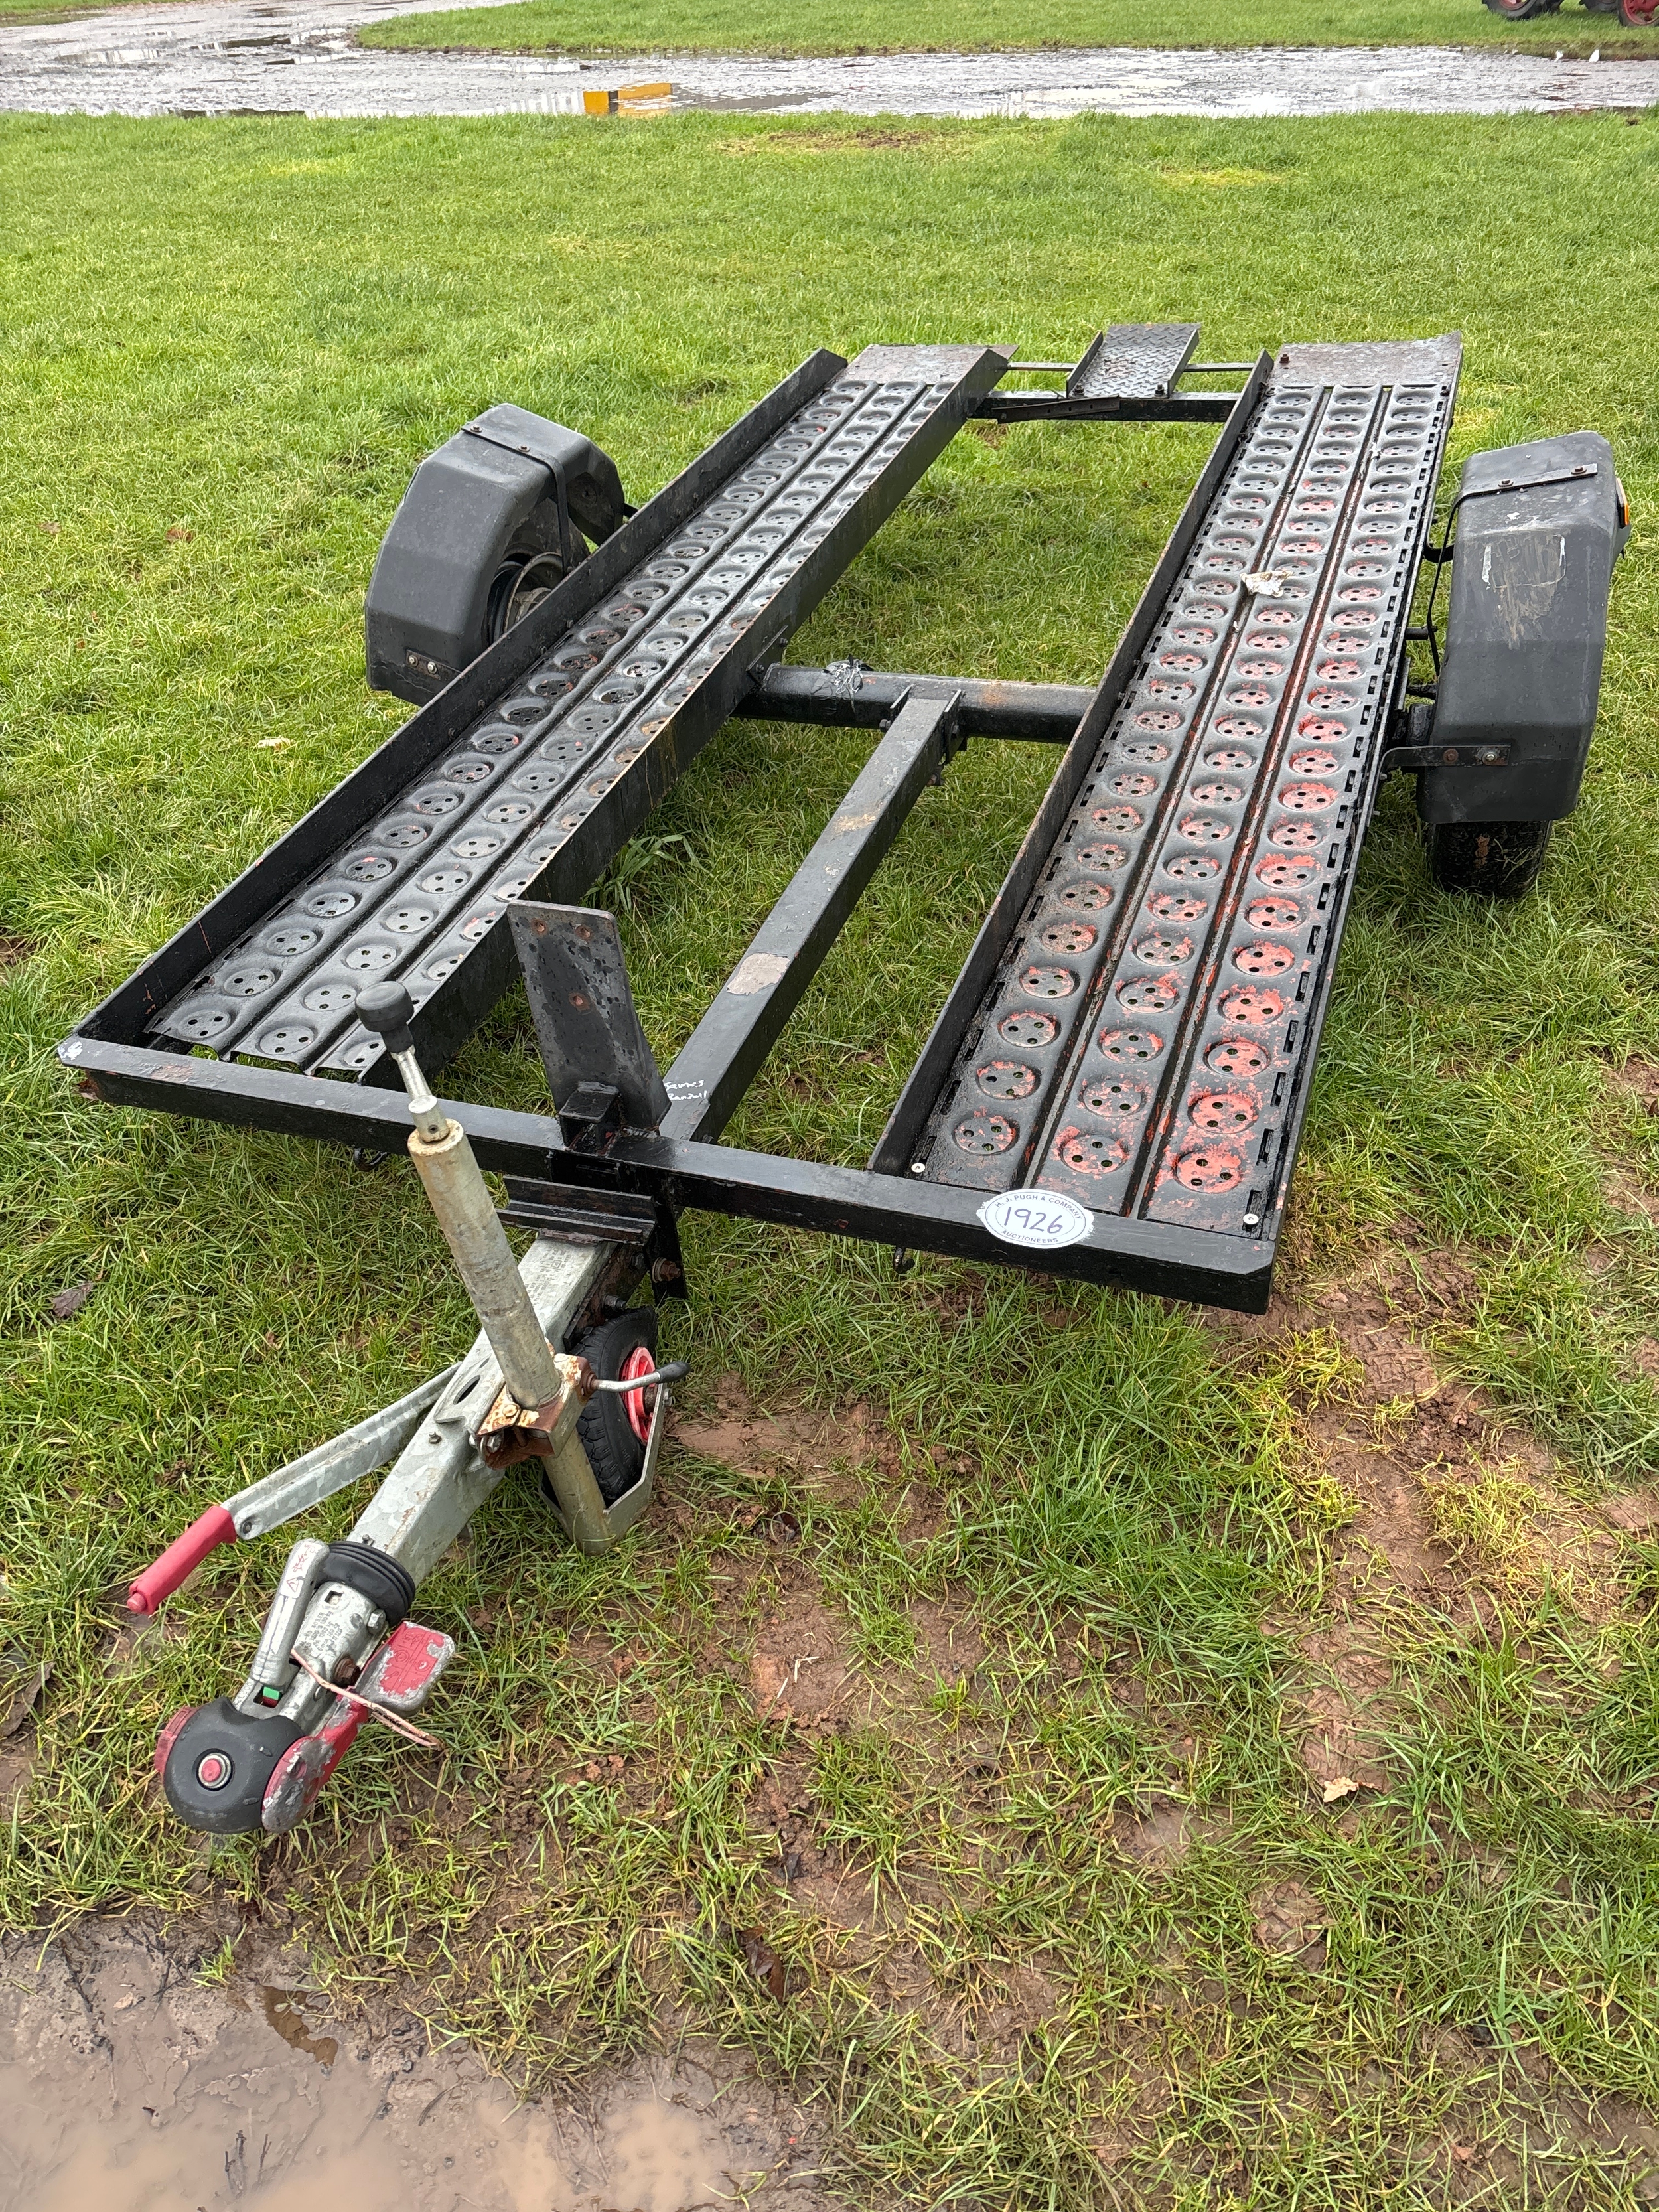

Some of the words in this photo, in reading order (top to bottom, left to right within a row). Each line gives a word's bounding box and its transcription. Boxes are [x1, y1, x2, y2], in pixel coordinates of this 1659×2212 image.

[1048, 1198, 1082, 1220] COMPANY
[1004, 1207, 1063, 1234] 1926
[1001, 1230, 1058, 1244] AUCTIONEERS
